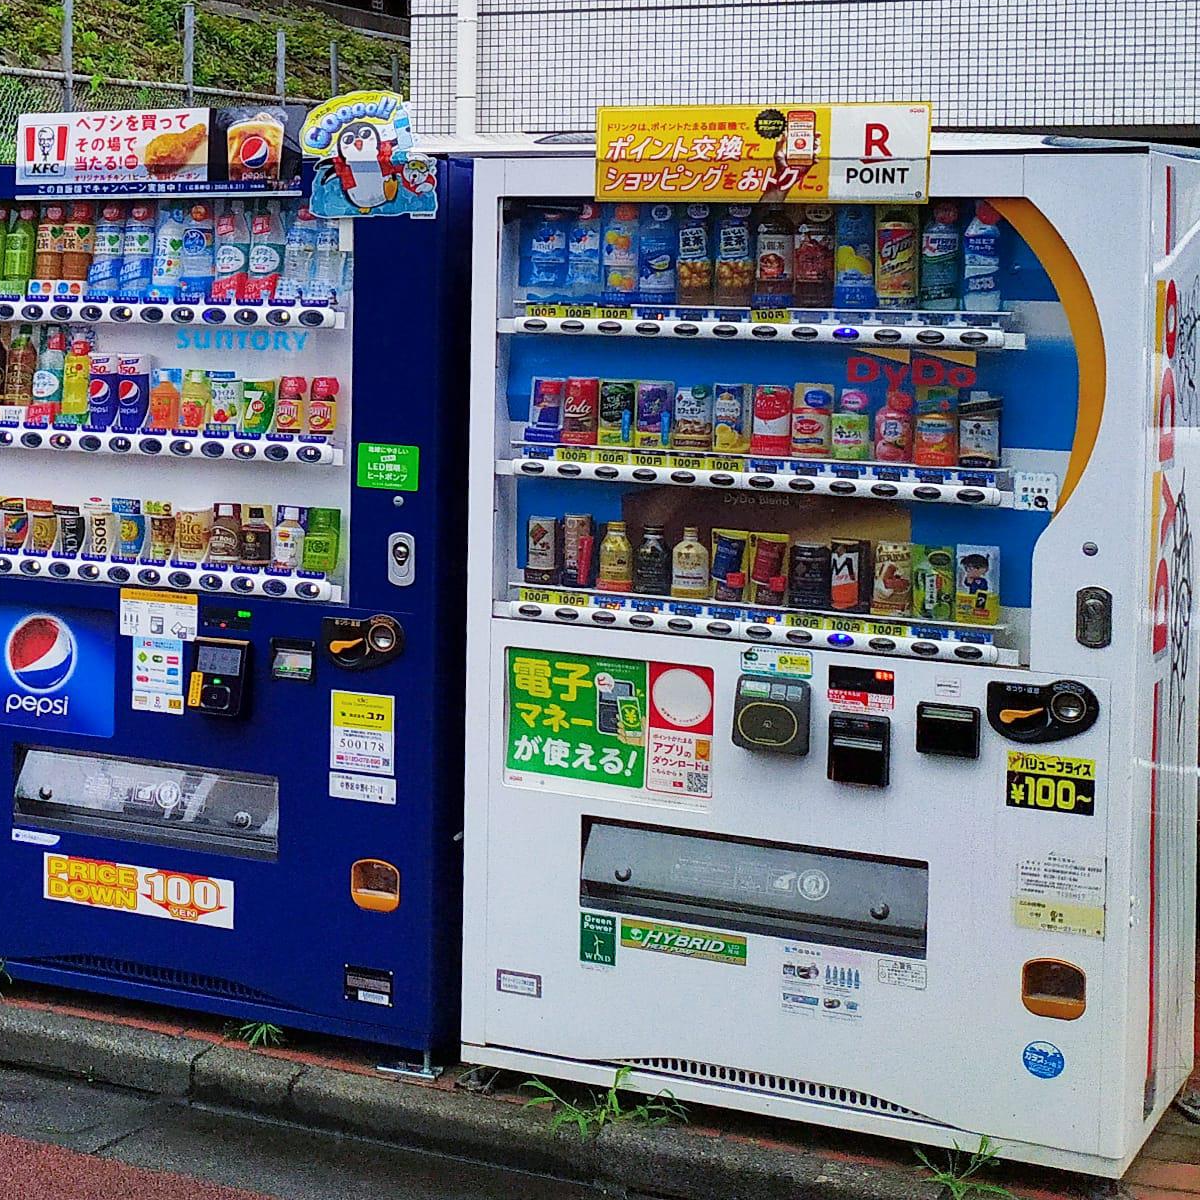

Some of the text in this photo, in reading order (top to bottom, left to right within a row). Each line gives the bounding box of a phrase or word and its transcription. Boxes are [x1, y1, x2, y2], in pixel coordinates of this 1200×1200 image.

[75, 113, 191, 132] ペプシを買って
[75, 136, 138, 153] その場で
[604, 134, 761, 162] ポイント交換で
[31, 163, 60, 174] KFC
[74, 154, 123, 172] 当たる!
[603, 163, 823, 192] ショッピングをおトクに。
[846, 167, 910, 185] POINT
[531, 307, 557, 317] 100円
[564, 307, 591, 317] 100円
[601, 308, 628, 319] 100円
[756, 310, 785, 320] 100円
[175, 328, 310, 352] SUNTORY
[846, 356, 978, 393] DyDo
[564, 396, 592, 415] Cola
[561, 451, 587, 461] 100円
[598, 453, 625, 463] 100円
[635, 455, 663, 465] 100円
[672, 457, 701, 468] 100円
[711, 460, 739, 471] 100円
[367, 471, 408, 482] ヒートポンプ
[758, 495, 790, 506] Blend
[63, 516, 79, 553] BLACK
[93, 517, 107, 555] BOSS
[179, 522, 201, 535] BIG
[524, 591, 550, 602] 100円
[558, 595, 585, 606] 100円
[790, 616, 819, 629] 100円
[831, 620, 861, 632] 100円
[872, 624, 903, 636] 100円
[513, 656, 593, 702] 電子
[5, 693, 69, 717] pepsi
[515, 702, 593, 733] マネー
[339, 737, 385, 753] 500178
[652, 741, 692, 758] アプリの
[513, 734, 638, 777] が使える!
[651, 754, 710, 772] ダウンロードは
[1018, 757, 1092, 777] バリュープライス
[48, 855, 138, 889] PRICE
[48, 877, 138, 910] DOWN
[145, 870, 222, 912] 100
[170, 907, 198, 920] YEN
[583, 914, 613, 926] Green
[583, 921, 614, 934] Power
[640, 929, 726, 953] HYBRID
[584, 951, 612, 963] WIND
